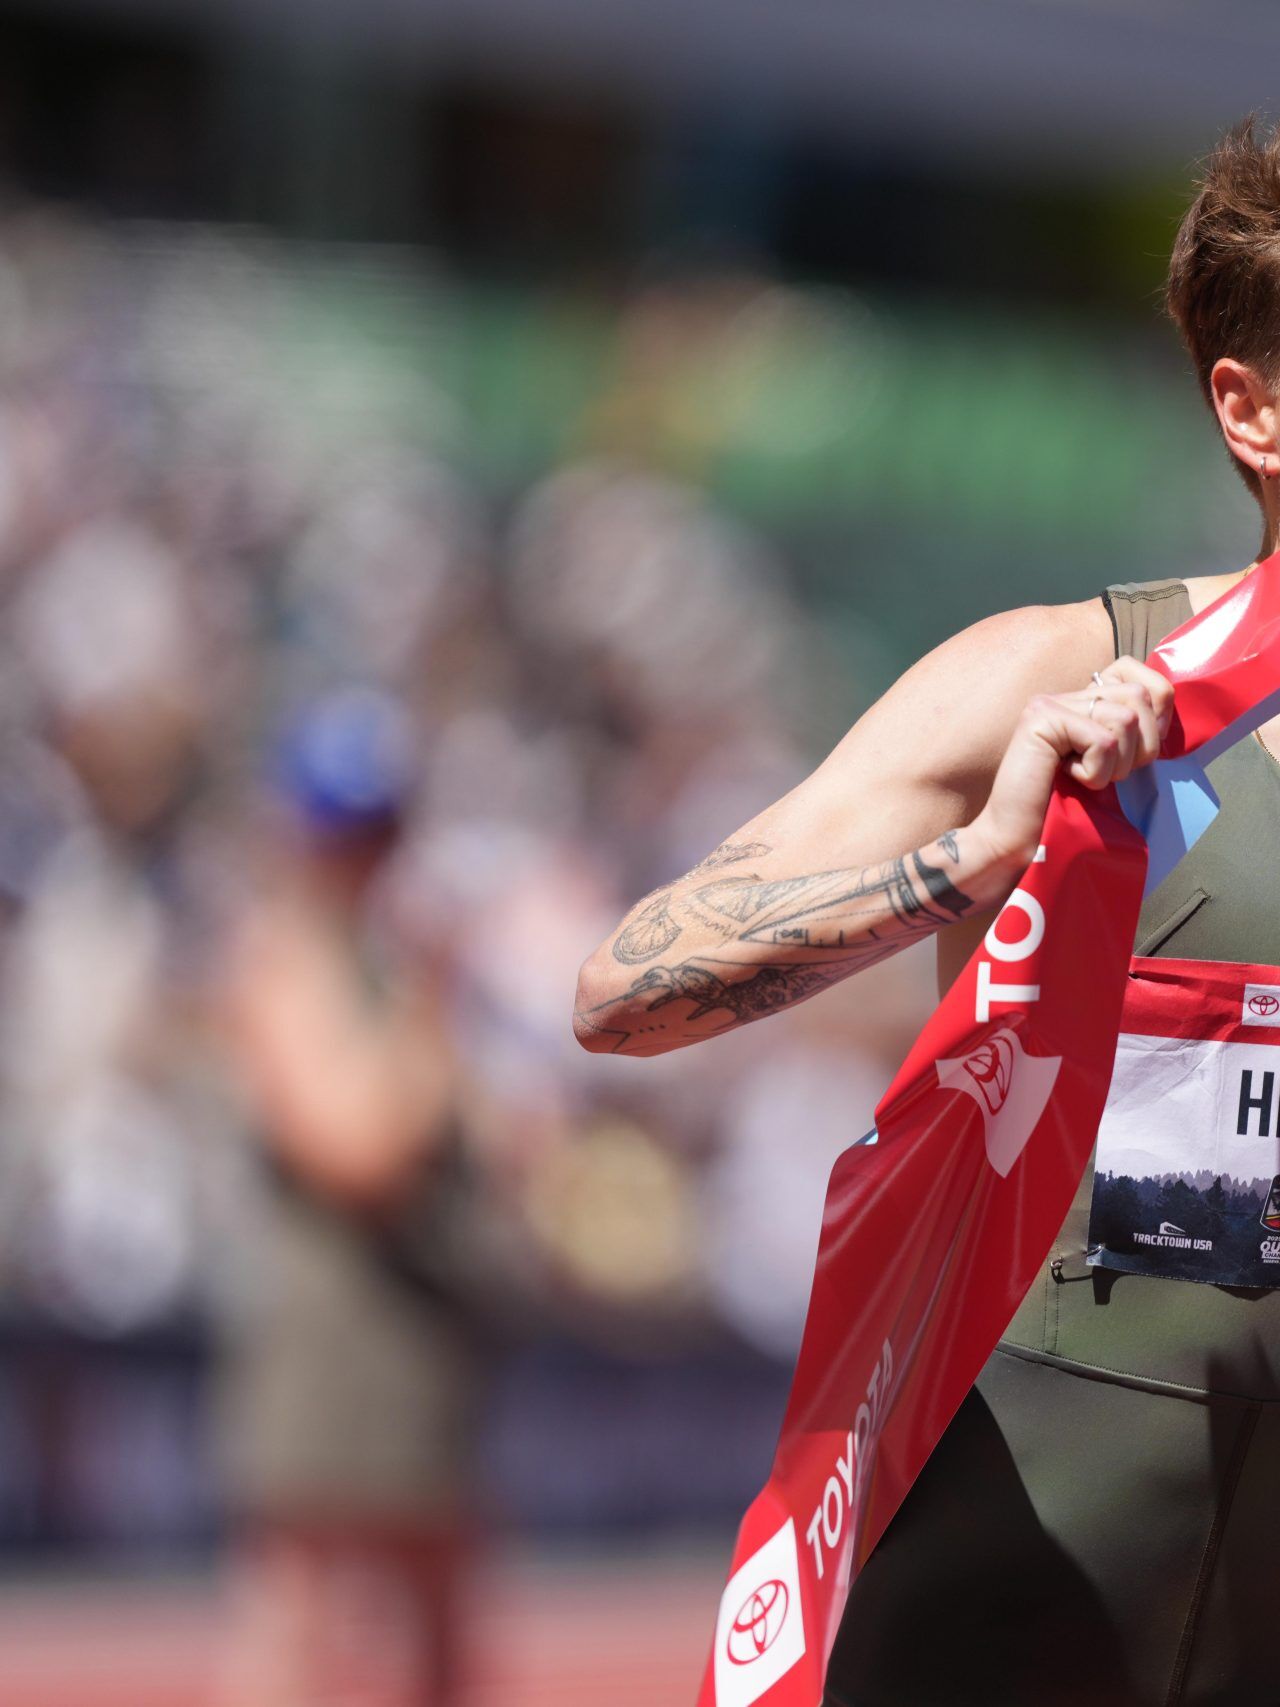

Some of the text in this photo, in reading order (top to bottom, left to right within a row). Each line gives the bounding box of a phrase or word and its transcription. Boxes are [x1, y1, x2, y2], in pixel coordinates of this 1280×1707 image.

[1133, 1232, 1213, 1251] TRACKTOWN USA
[806, 1337, 893, 1580] TOYOTA
